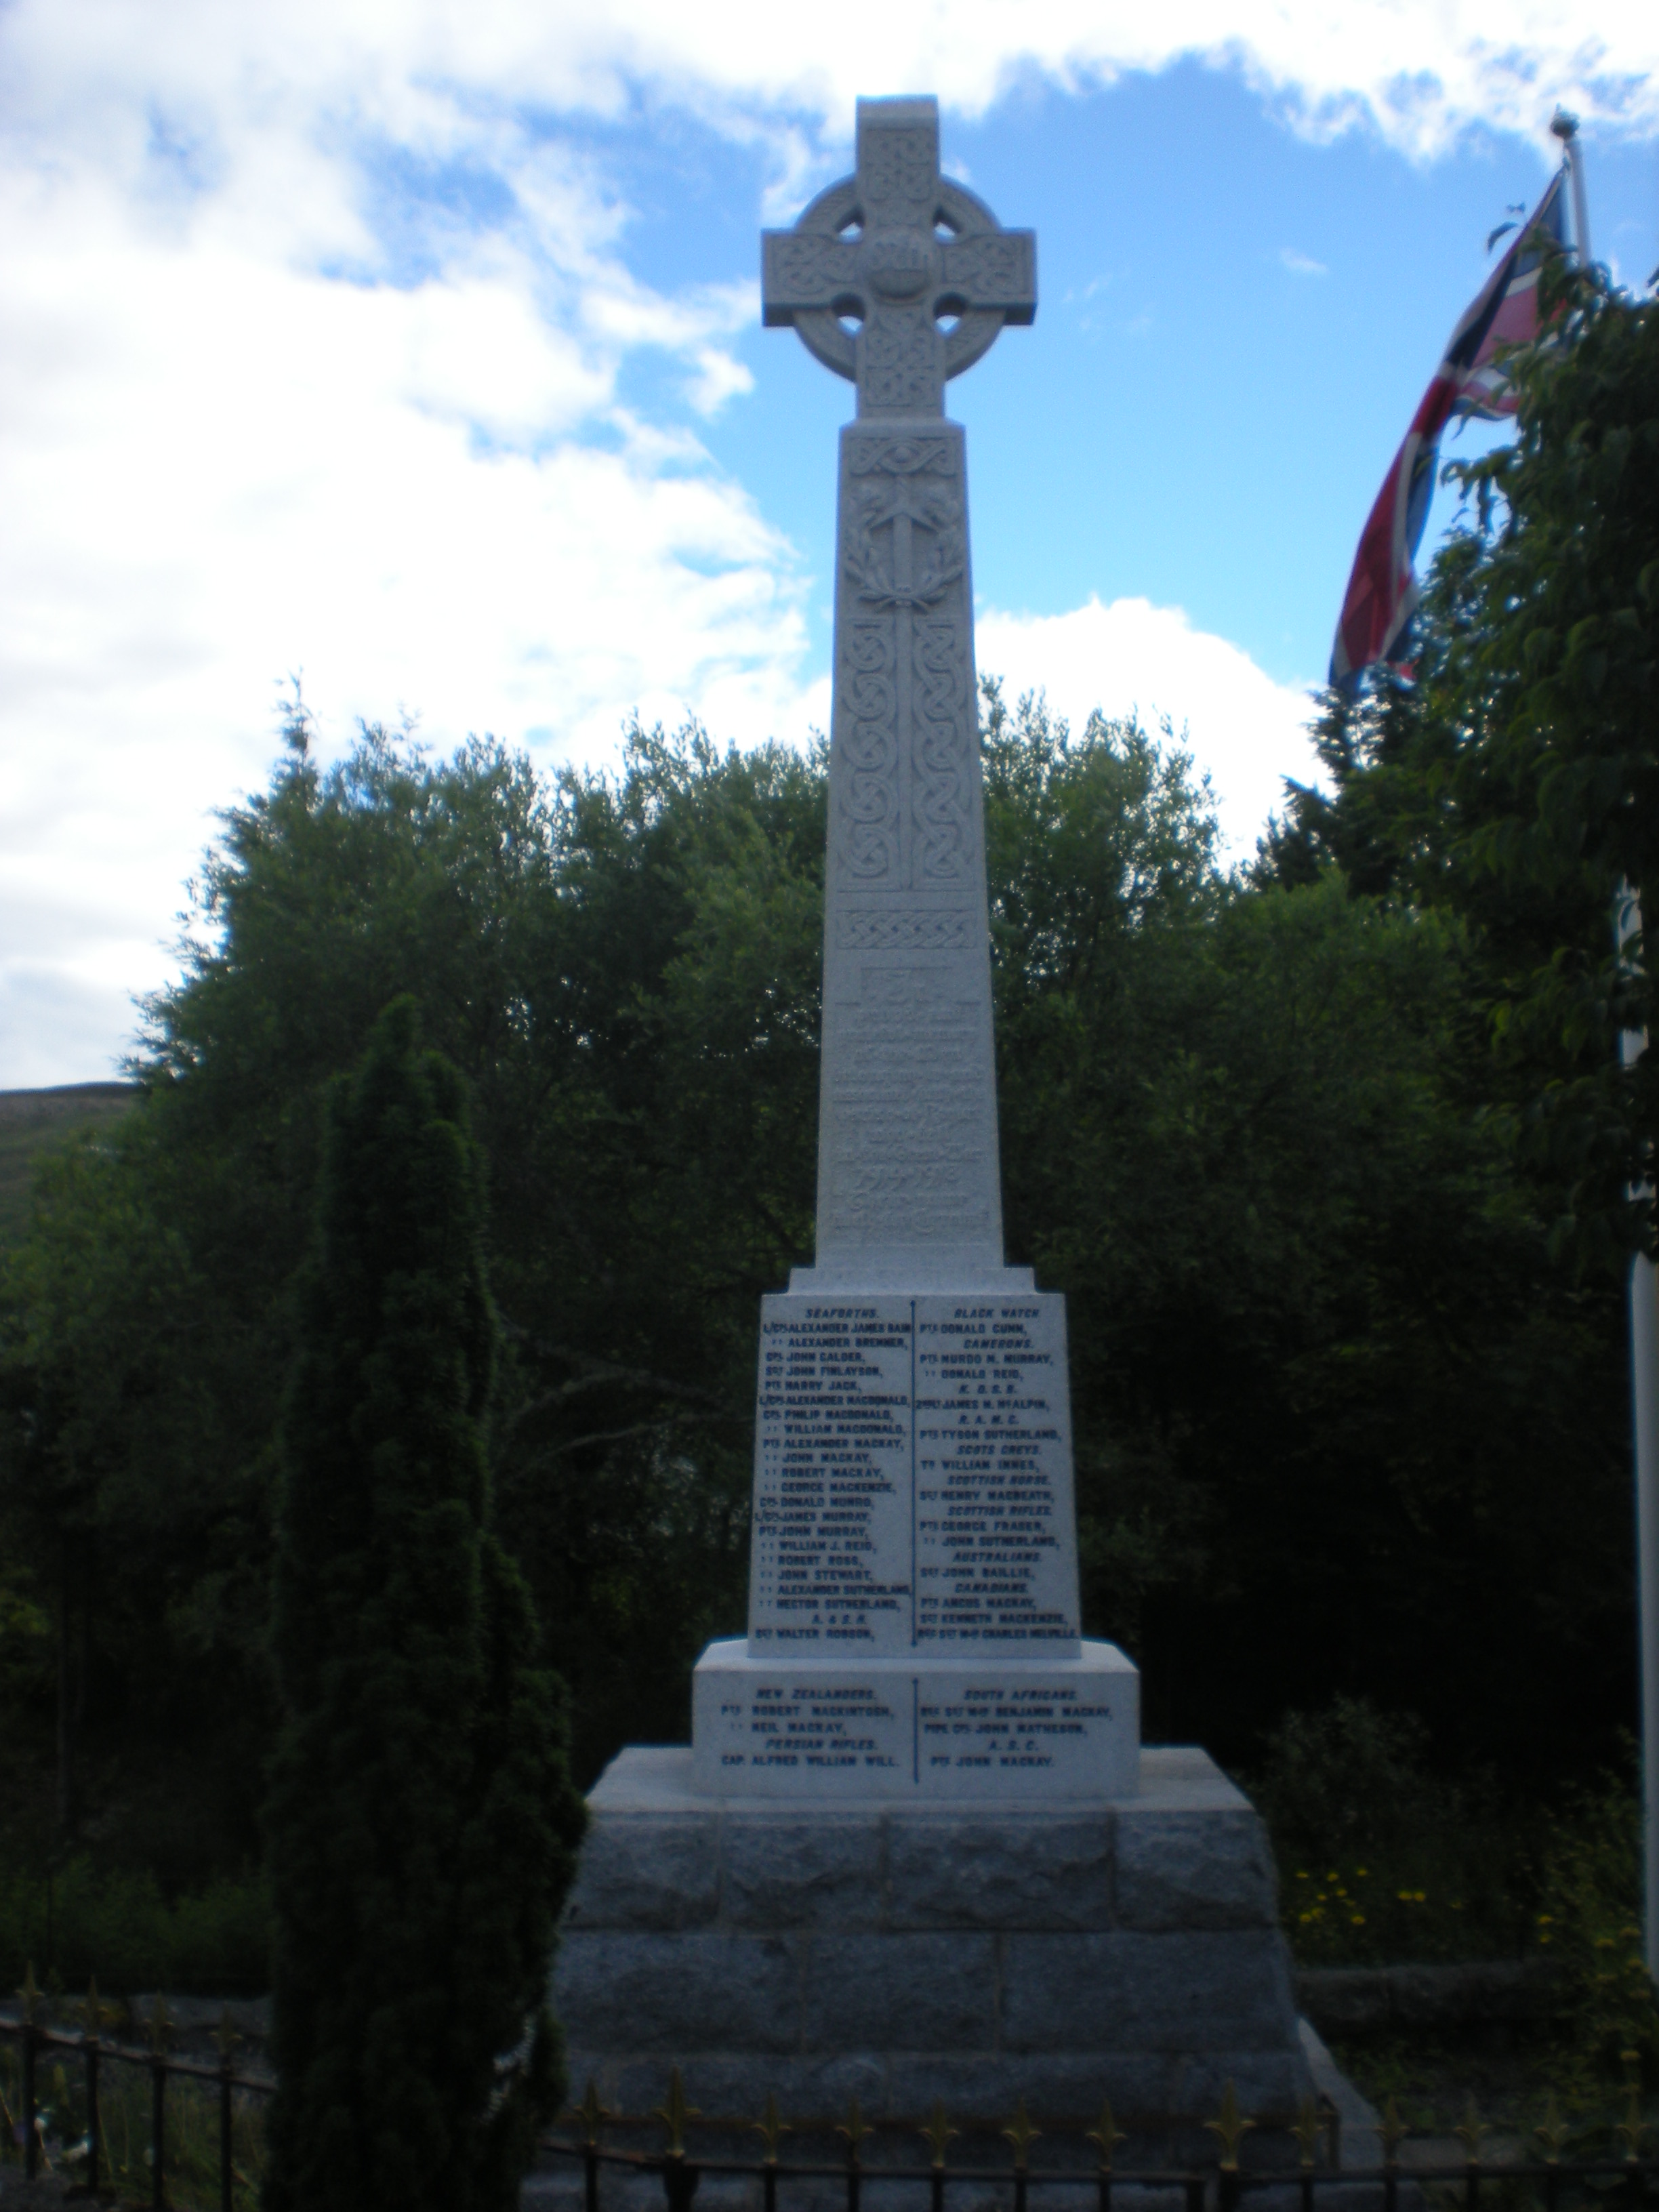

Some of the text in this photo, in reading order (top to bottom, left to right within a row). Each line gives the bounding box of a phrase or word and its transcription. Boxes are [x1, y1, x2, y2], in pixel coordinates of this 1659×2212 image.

[787, 1353, 815, 1361] JOHN
[787, 1367, 815, 1376] JOHN
[785, 1425, 832, 1433] WILLIAM
[782, 1454, 813, 1462] JOHN
[942, 1460, 990, 1469] WILLIAM
[779, 1542, 825, 1551] WILLIAM
[942, 1537, 973, 1547] JOHN
[778, 1571, 807, 1580] JOHN
[942, 1568, 974, 1578] JOHN
[806, 1755, 857, 1766] WILLIAM
